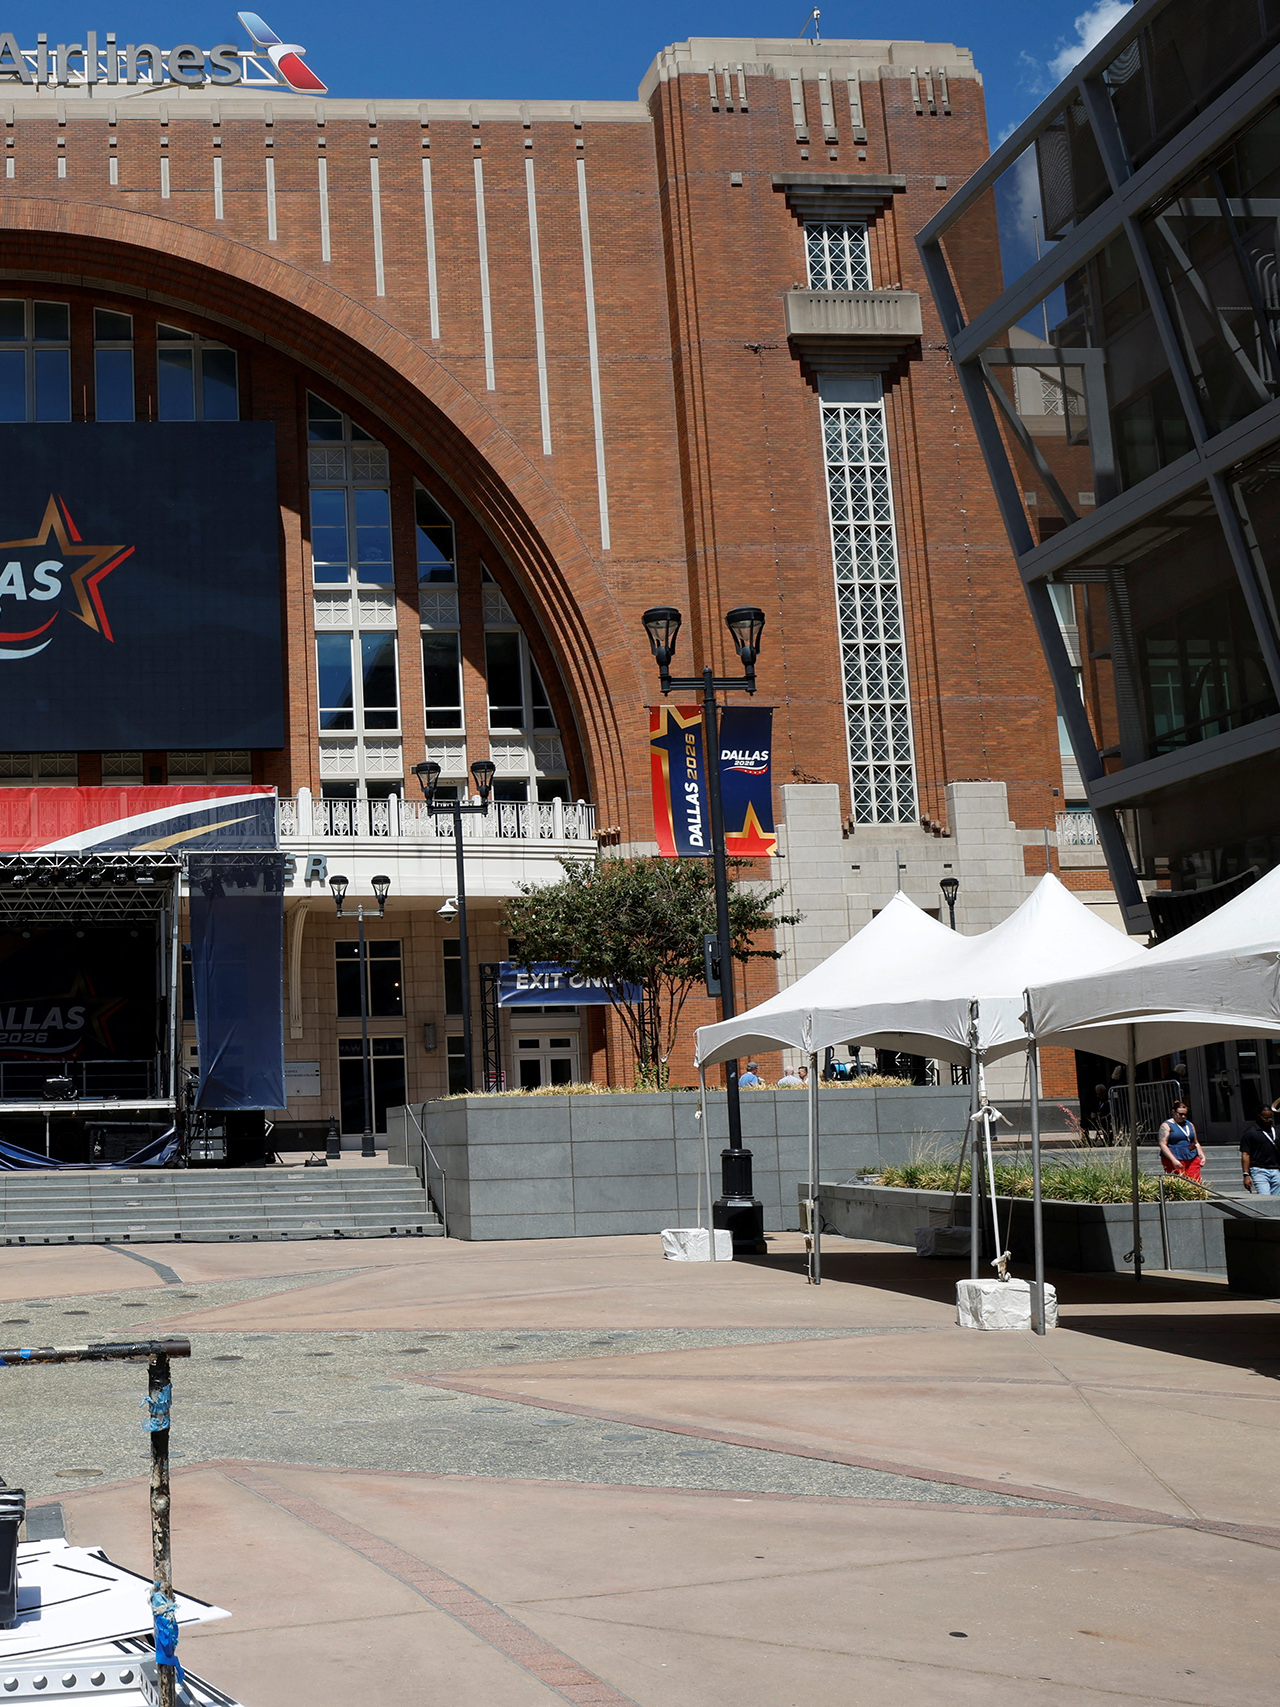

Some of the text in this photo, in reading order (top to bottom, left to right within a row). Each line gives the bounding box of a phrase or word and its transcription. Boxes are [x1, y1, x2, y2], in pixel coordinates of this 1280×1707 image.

[721, 750, 769, 761] DALLAS
[684, 733, 704, 847] DALLAS 2026
[516, 973, 563, 989] EXIT
